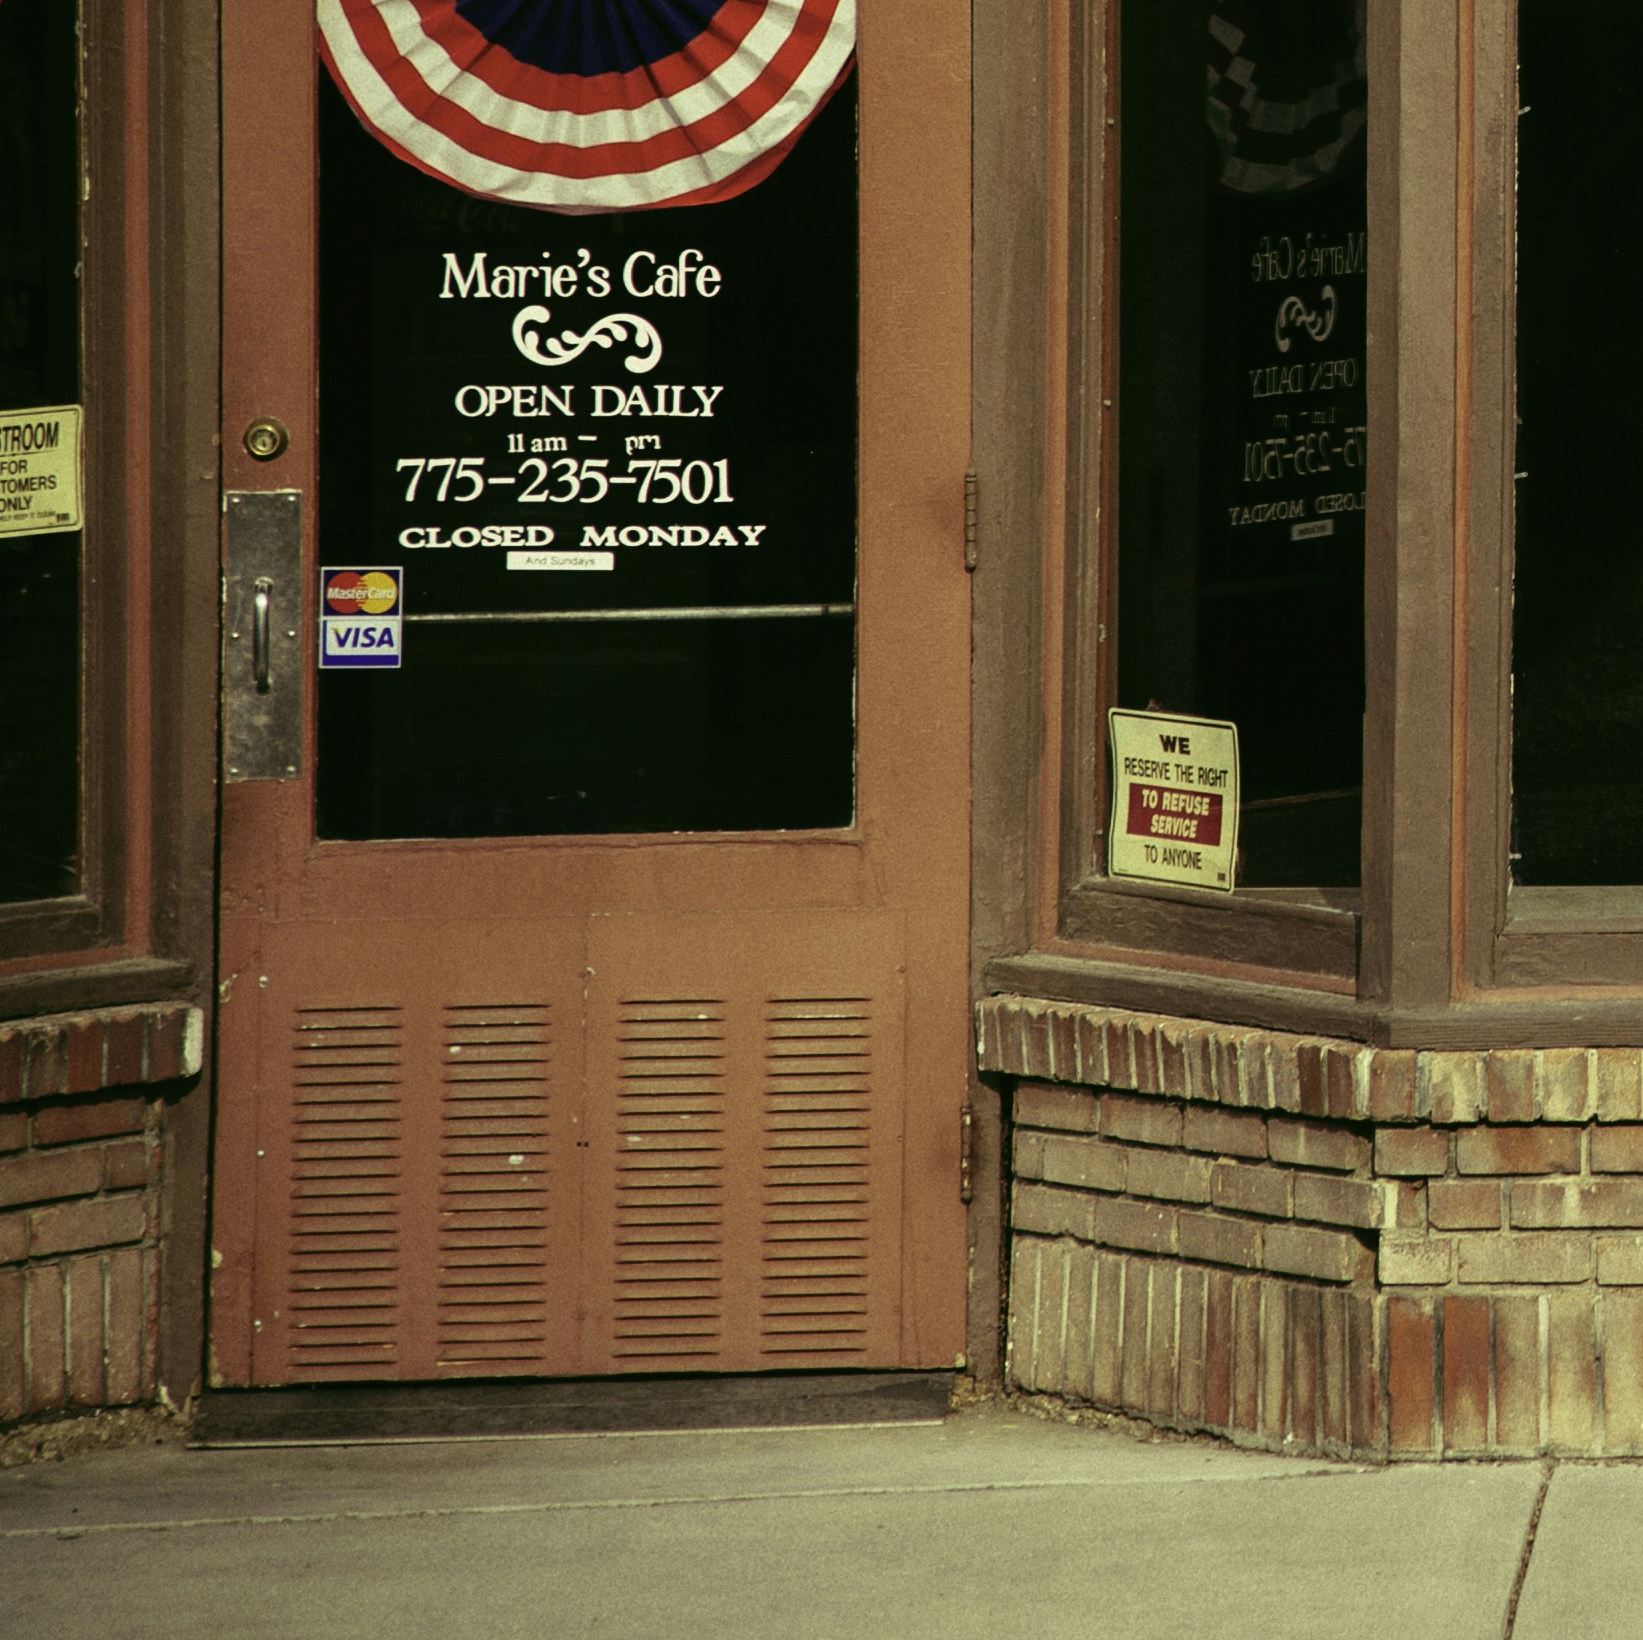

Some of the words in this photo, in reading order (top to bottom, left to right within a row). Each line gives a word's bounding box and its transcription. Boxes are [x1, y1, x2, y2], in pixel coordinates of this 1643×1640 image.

[439, 248, 611, 298] Marie's
[623, 249, 722, 298] Cafe
[455, 385, 575, 417] OPEN
[591, 386, 723, 417] DAILY
[396, 458, 734, 503] 775-235-7501
[399, 526, 555, 549] CLOSED
[579, 525, 766, 547] MONDAY
[526, 556, 546, 565] And
[550, 556, 595, 566] Sundays
[326, 587, 396, 600] MasterCard
[333, 626, 394, 648] VISA
[1159, 734, 1191, 755] WE
[1124, 758, 1171, 780] RESERVE
[1175, 764, 1194, 784] THE
[1197, 767, 1228, 788] RIGHT
[1142, 789, 1158, 808] TO
[1162, 792, 1210, 816] REFUSE
[1150, 815, 1198, 838] SERVICE
[1145, 844, 1158, 863] TO
[1162, 847, 1202, 869] ANYONE
